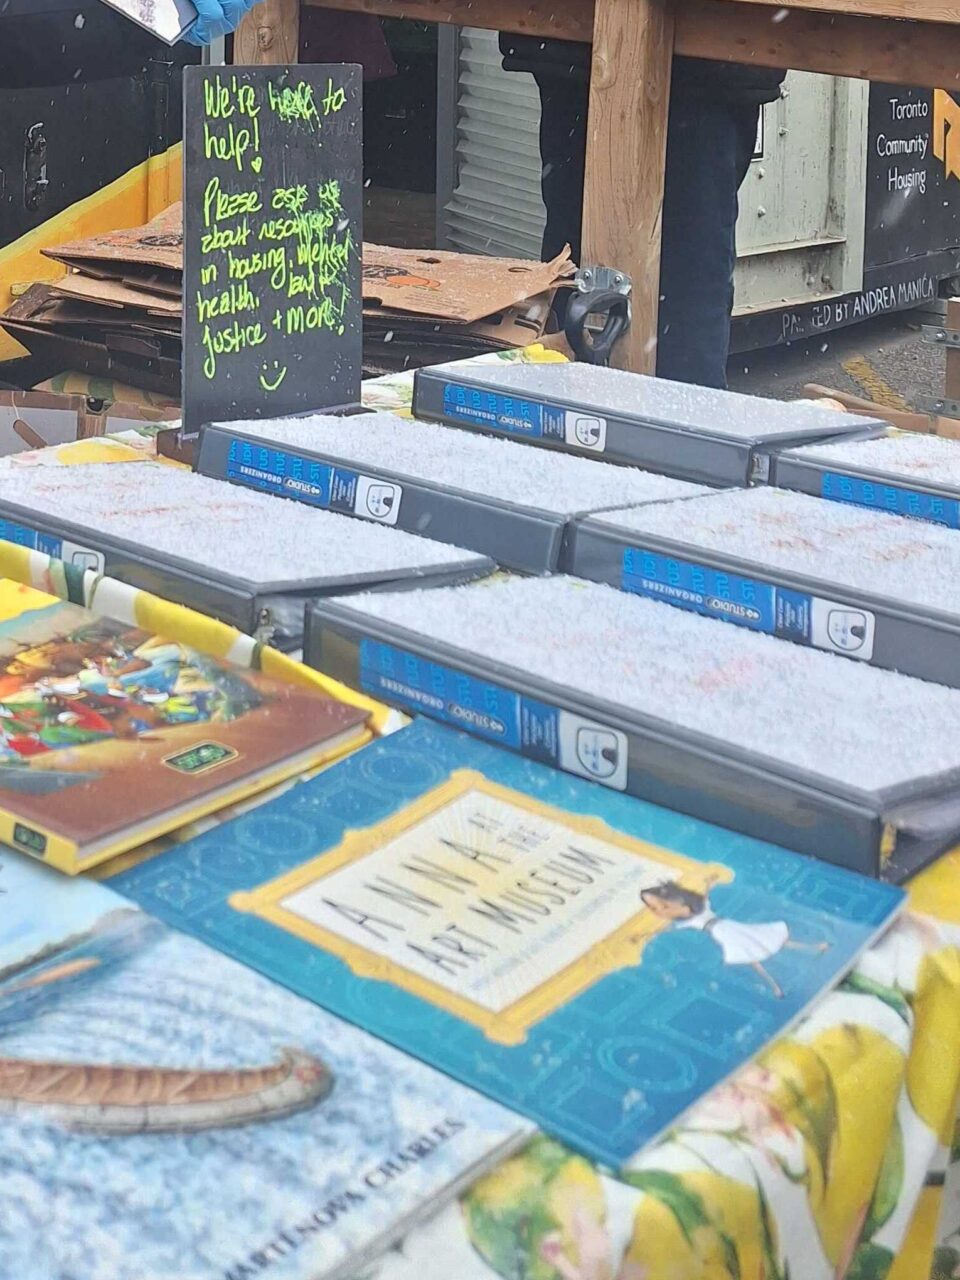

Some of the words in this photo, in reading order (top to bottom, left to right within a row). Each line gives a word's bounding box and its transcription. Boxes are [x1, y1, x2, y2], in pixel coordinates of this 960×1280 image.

[204, 75, 260, 118] We're
[322, 78, 347, 116] to
[889, 98, 928, 120] Toronto
[204, 117, 259, 171] help!
[876, 134, 928, 160] Community
[888, 167, 926, 194] Housing
[204, 176, 263, 227] Please
[271, 184, 309, 211] ask
[201, 217, 251, 254] about
[201, 263, 217, 285] in
[852, 284, 896, 318] ANDREA
[240, 465, 282, 484] ORGANIZERS
[641, 579, 703, 605] ORGANIZERS
[321, 837, 512, 943] ANNA
[406, 924, 499, 977] ART
[467, 845, 617, 936] MUSEUM
[364, 1117, 466, 1189] CHARLES
